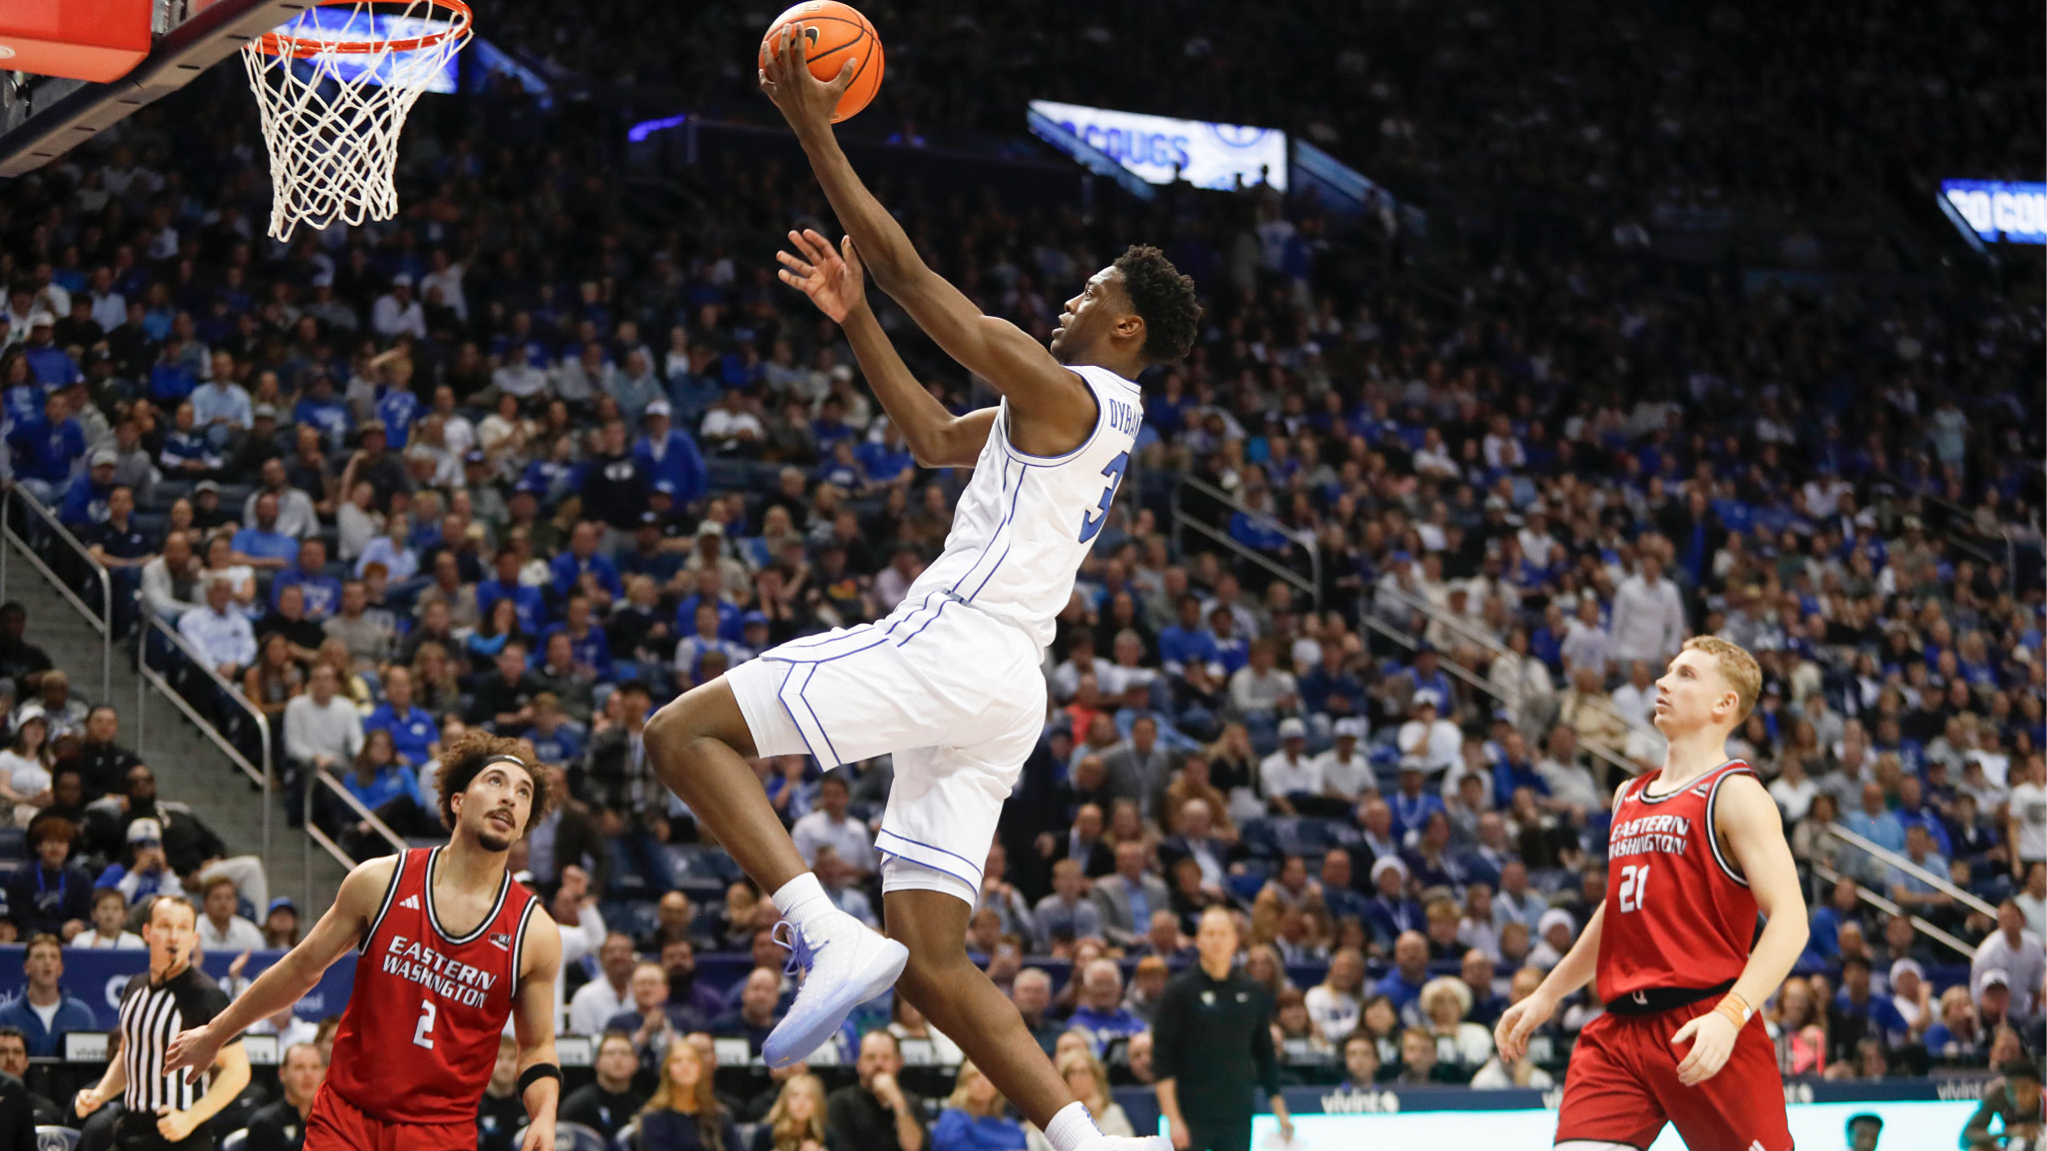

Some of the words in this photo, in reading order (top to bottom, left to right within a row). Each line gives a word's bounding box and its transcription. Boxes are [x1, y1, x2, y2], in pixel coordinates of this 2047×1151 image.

[1078, 450, 1129, 544] 3
[1611, 815, 1690, 842] EASTERN
[1619, 864, 1649, 914] 21
[388, 934, 497, 991] EASTERN
[412, 998, 437, 1050] 2
